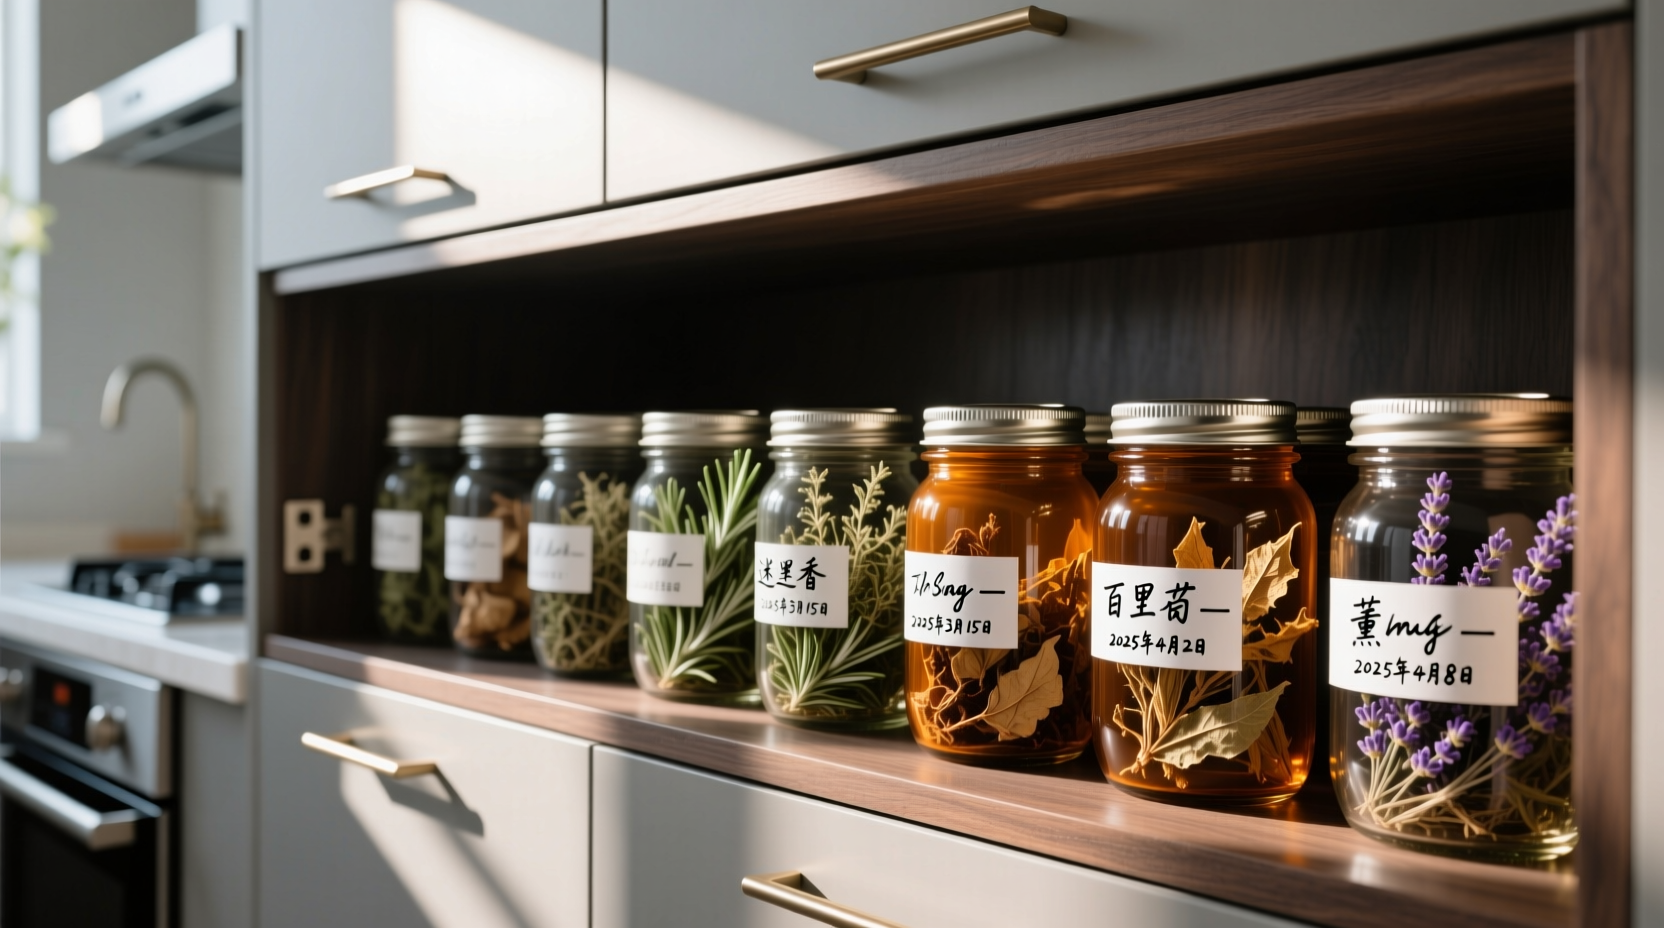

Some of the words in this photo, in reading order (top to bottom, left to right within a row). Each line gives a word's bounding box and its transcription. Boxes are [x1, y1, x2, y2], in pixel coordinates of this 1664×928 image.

[1108, 629, 1206, 657] 2025年4月2日
[1353, 656, 1473, 686] 2025年4月8日
